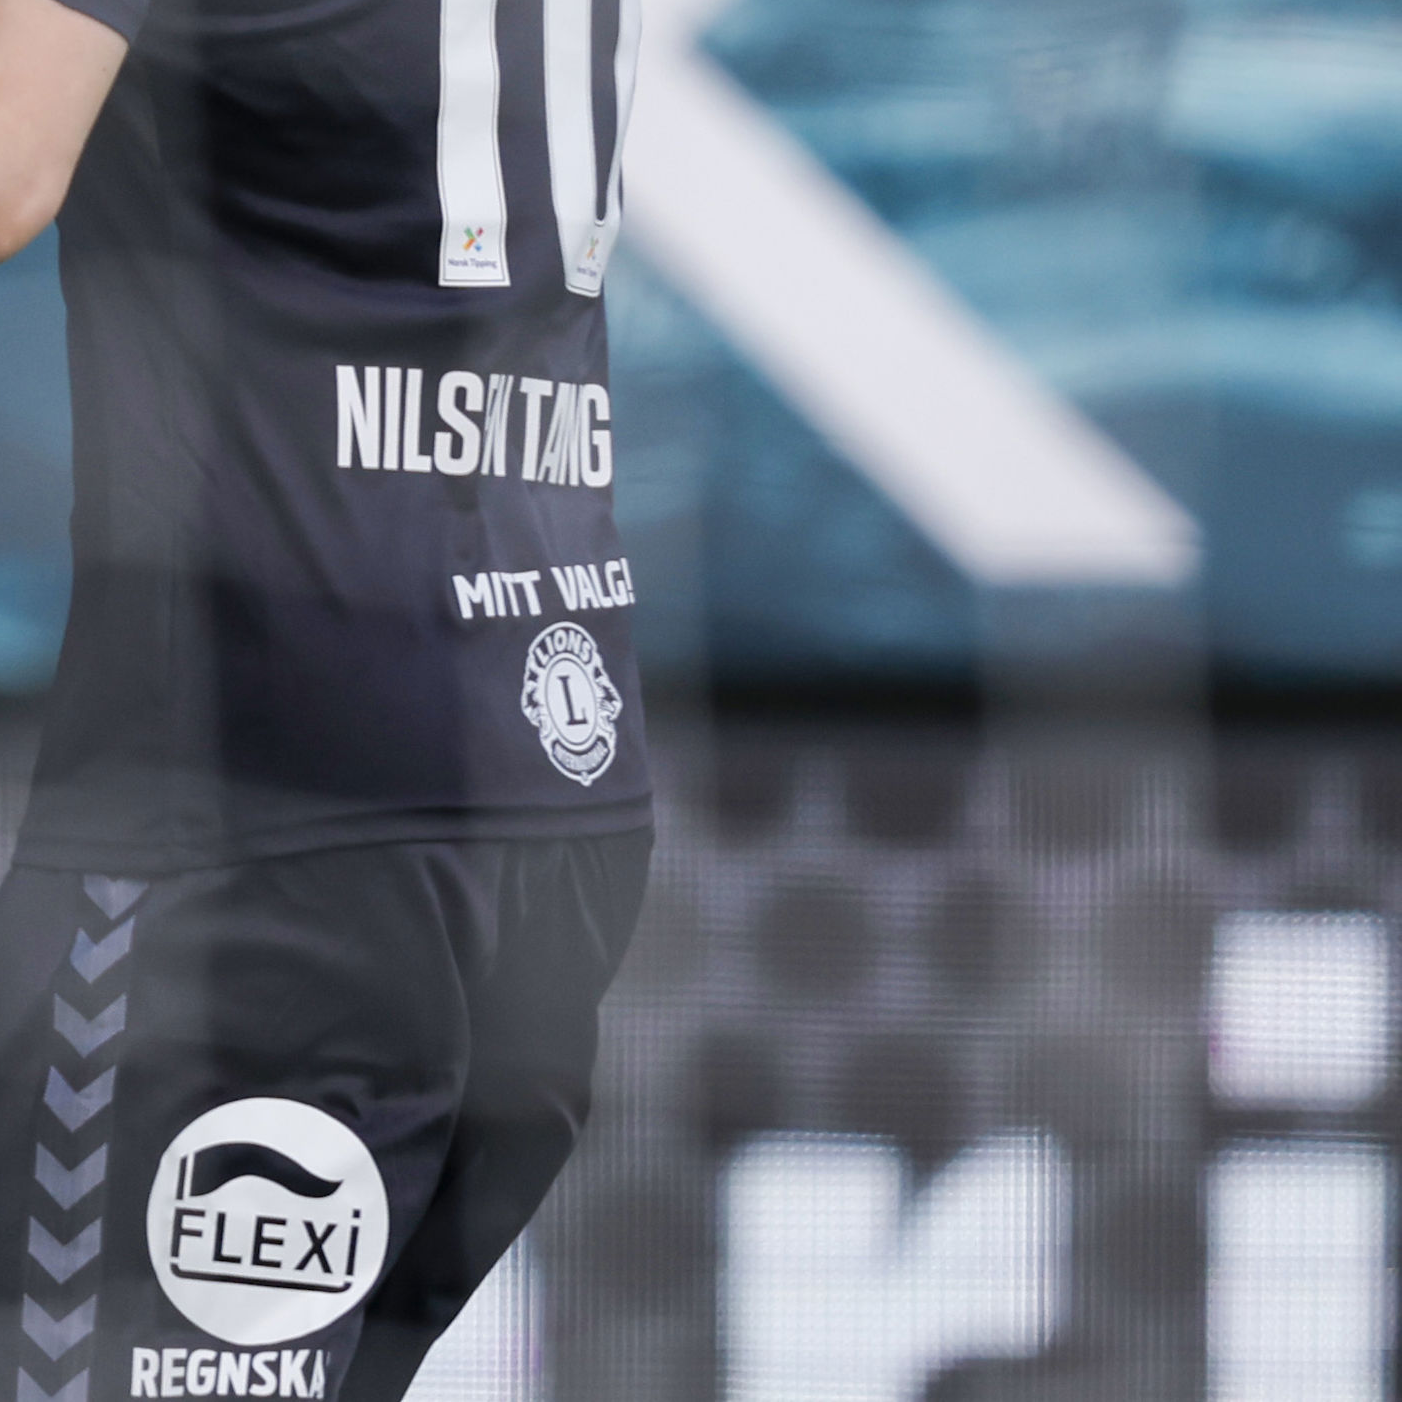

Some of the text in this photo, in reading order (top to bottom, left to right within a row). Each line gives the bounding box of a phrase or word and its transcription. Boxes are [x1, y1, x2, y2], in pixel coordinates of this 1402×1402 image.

[452, 557, 636, 620] MITT VALG!
[535, 629, 592, 664] LIONS
[556, 674, 589, 726] L
